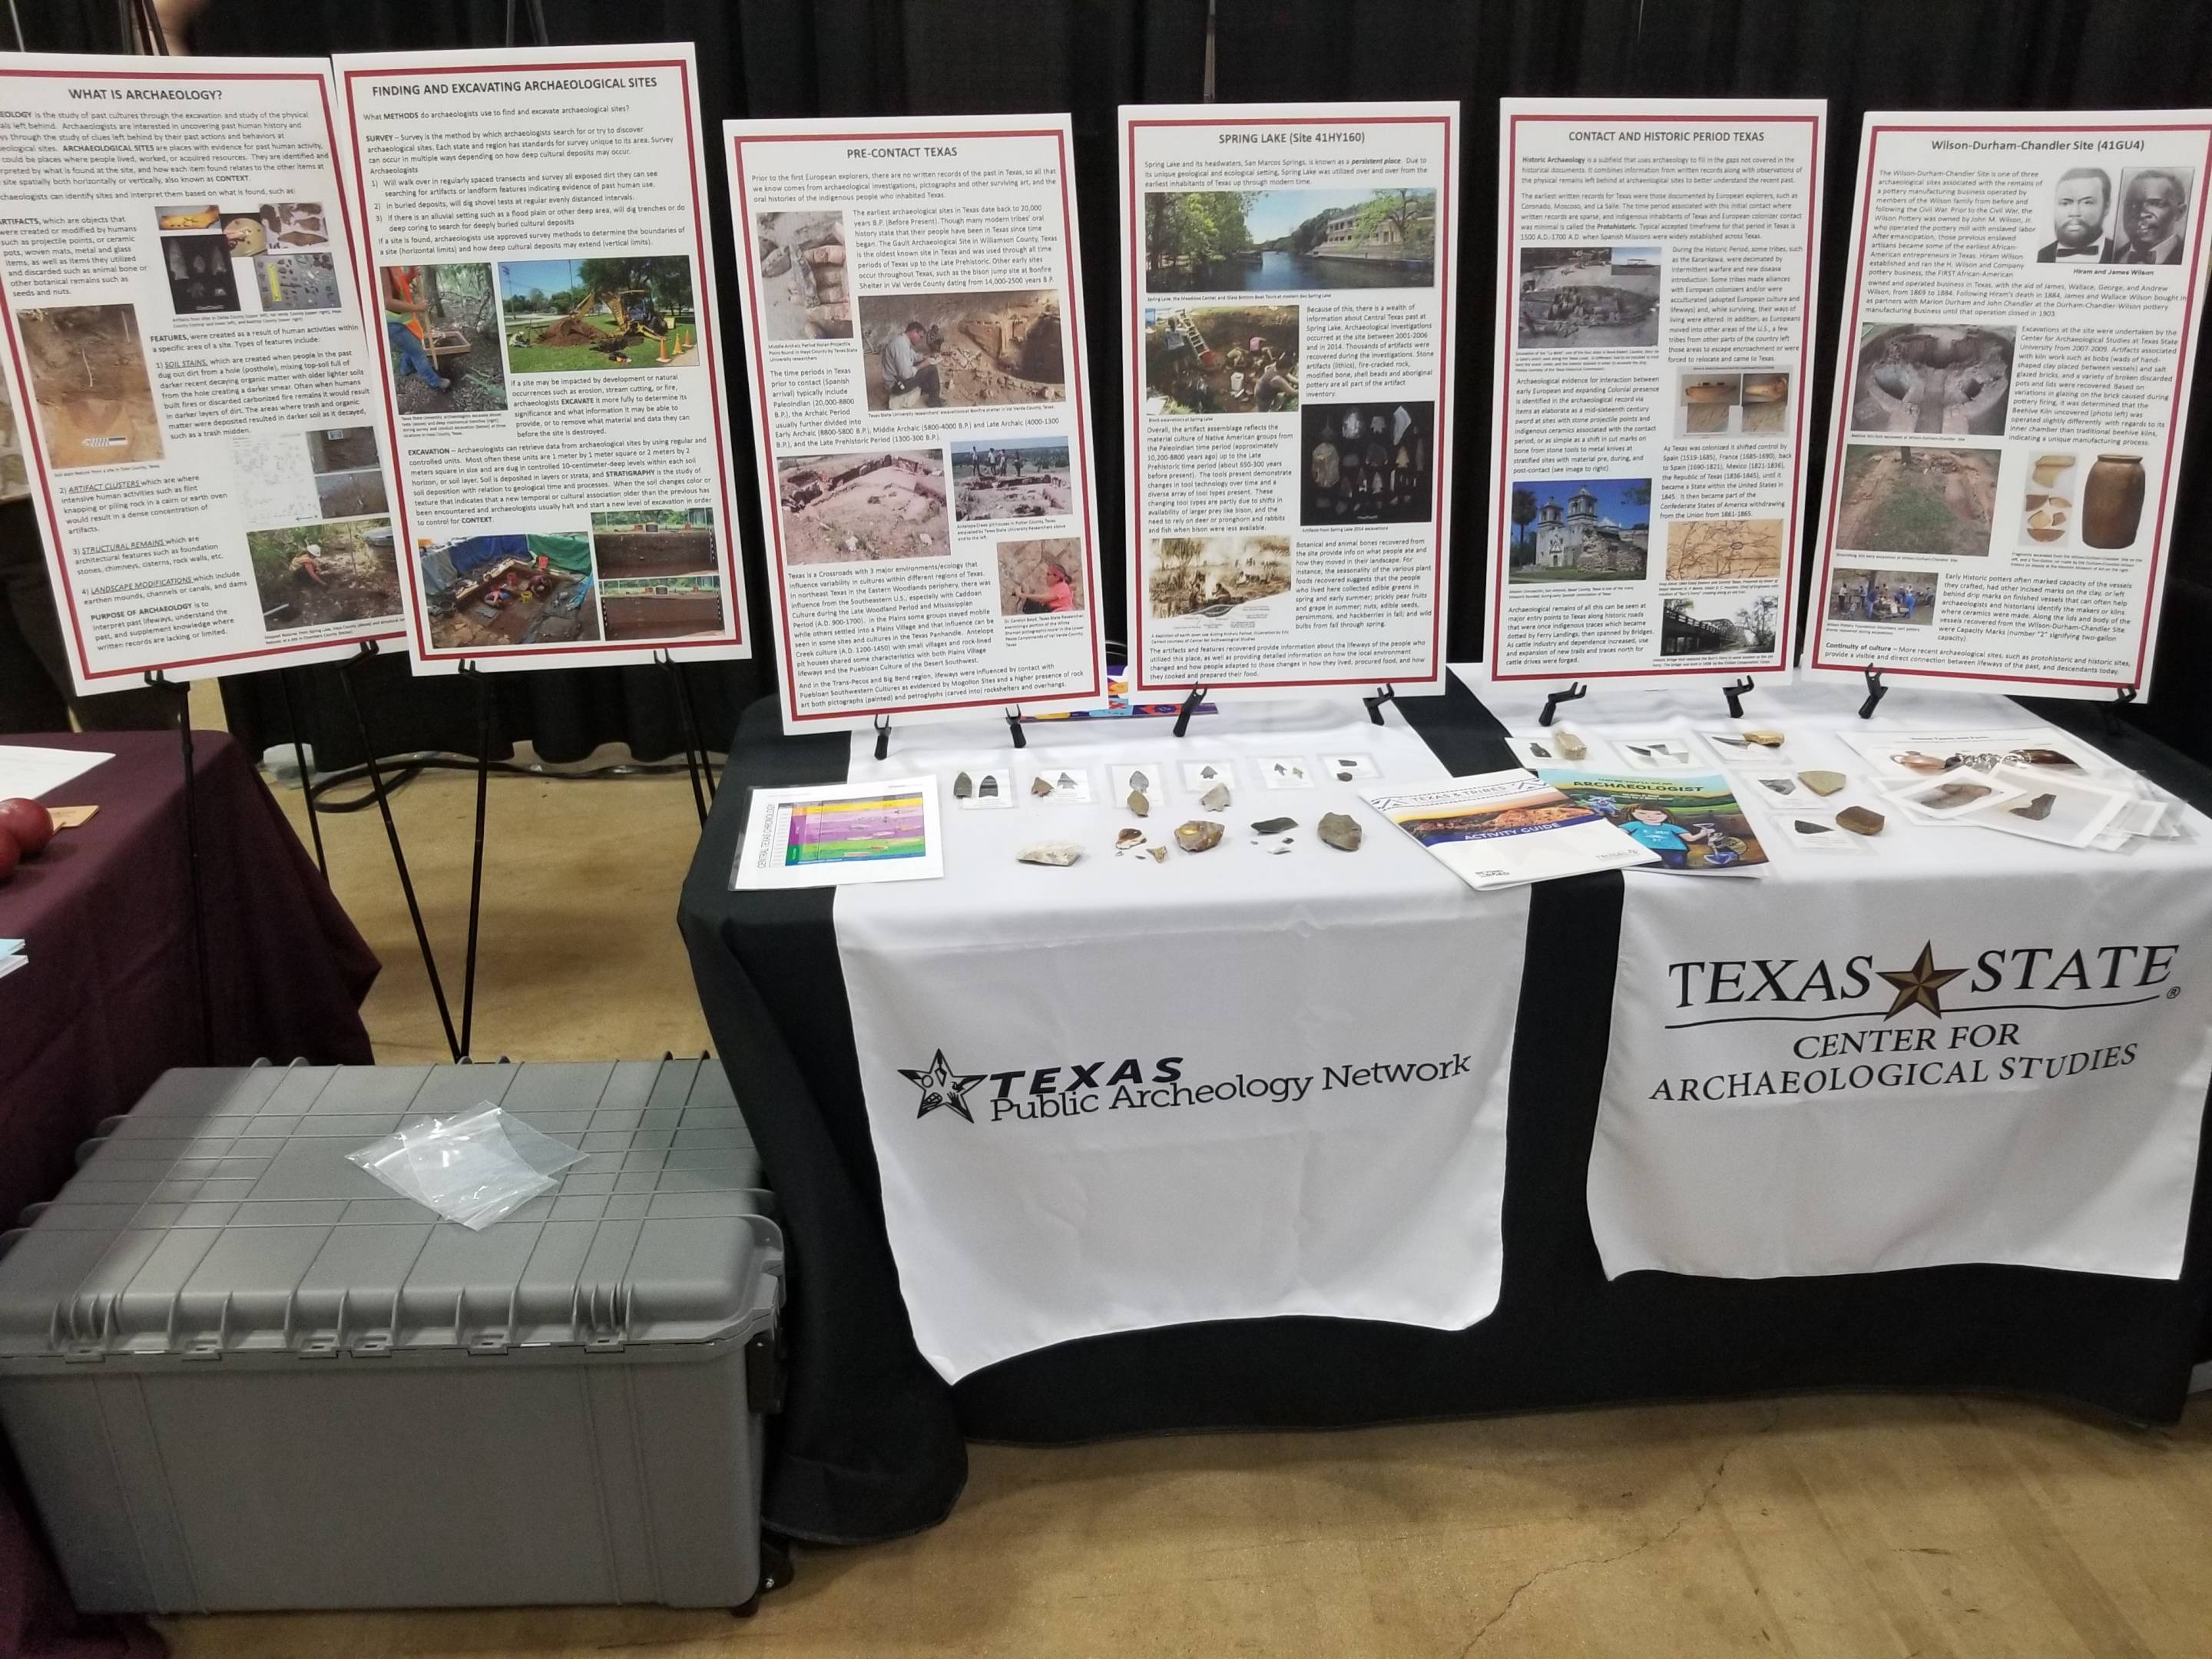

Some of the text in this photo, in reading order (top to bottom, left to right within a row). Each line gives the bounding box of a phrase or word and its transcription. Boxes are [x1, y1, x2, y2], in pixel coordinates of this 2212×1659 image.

[372, 77, 657, 97] FINDING AND EXCAVATING ARCHAEOLOGICAL SITES
[68, 88, 223, 100] WHAT IS ARCHAEOLOGY?
[383, 111, 419, 120] METHODS
[431, 110, 478, 119] archaeologists
[502, 108, 515, 116] find
[562, 104, 608, 114] archaeological
[611, 104, 628, 112] sites?
[1217, 131, 1365, 145] SPRING LAKE (Site 41HY160)
[1568, 131, 1766, 141] CONTACT AND HISTORIC PERIOD TEXAS
[1931, 139, 2144, 152] Wilson-Durham-Chandler Site (41GU4)
[846, 146, 958, 159] PRE-CONTACT TEXAS
[1144, 180, 1168, 188] earliest
[1168, 179, 1205, 187] inhabitants
[1206, 178, 1214, 187] of
[1241, 178, 1268, 187] through
[902, 280, 922, 288] Verde
[922, 280, 945, 288] County
[946, 279, 967, 287] dating
[149, 333, 189, 343] FEATURES,
[273, 327, 280, 336] of
[306, 325, 336, 333] activities
[1345, 342, 1378, 350] Thousands
[571, 427, 608, 435] destroyed.
[806, 439, 819, 447] the
[834, 436, 869, 446] Prehistoric
[869, 435, 890, 444] Period
[892, 434, 924, 444] (1300-300
[68, 485, 103, 494] ARTIFACT
[104, 481, 141, 490] CLUSTERS
[426, 518, 449, 526] control
[90, 611, 125, 621] PURPOSE
[138, 602, 192, 615] ARCHAEOLOGY
[1558, 656, 1579, 664] forged.
[1150, 673, 1164, 681] they
[1199, 671, 1227, 680] prepared
[1465, 786, 1506, 796] TRIBES
[1573, 781, 1704, 792] ARCHAEOLOGIST
[1465, 823, 1561, 840] ACTIVITY GUIDE
[1667, 955, 1873, 1008] TEXAS
[1971, 944, 2180, 993] STATE
[1793, 1022, 2020, 1060] CENTER FOR
[990, 1057, 1184, 1098] TEXAS
[1648, 1043, 2137, 1102] ARCHAEOLOGICAL STUDIES
[991, 1053, 1471, 1121] Public Archeology Network
